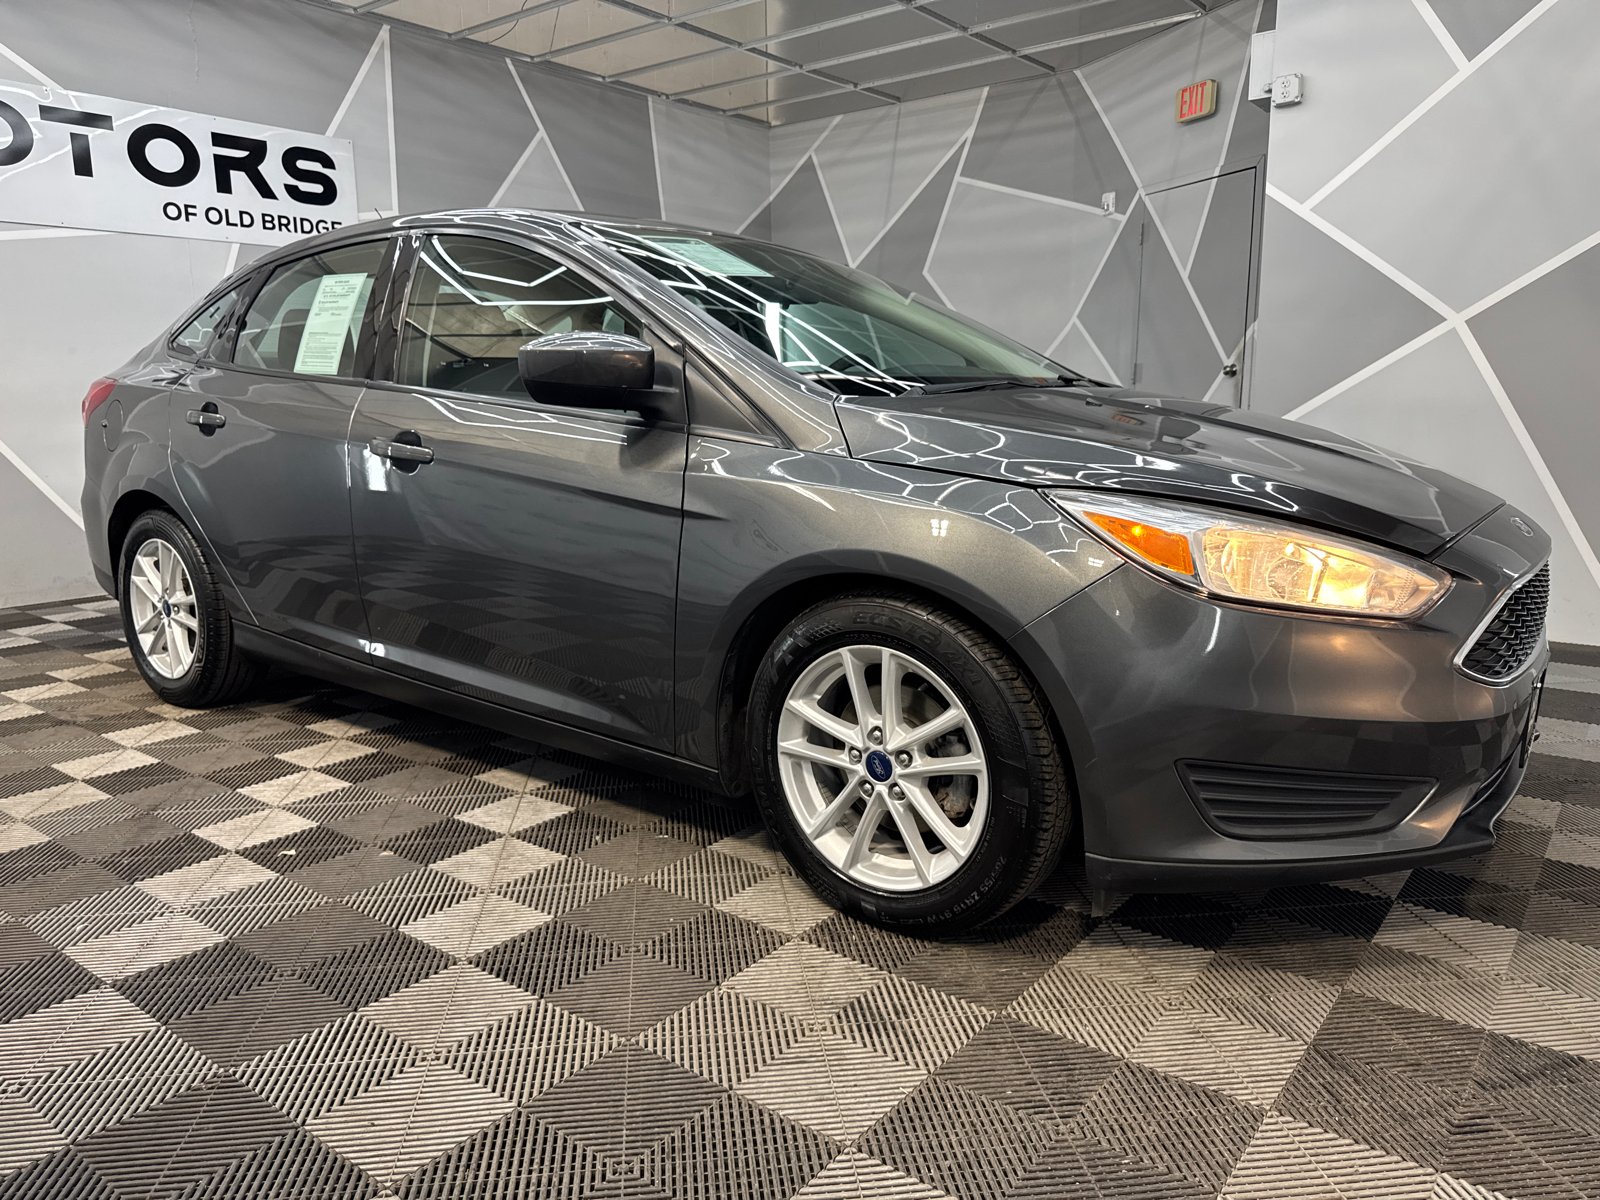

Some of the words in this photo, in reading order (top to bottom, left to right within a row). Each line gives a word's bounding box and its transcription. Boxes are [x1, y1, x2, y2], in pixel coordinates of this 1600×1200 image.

[1180, 82, 1207, 118] EXIT
[162, 202, 198, 222] OF
[204, 207, 255, 229] OLD
